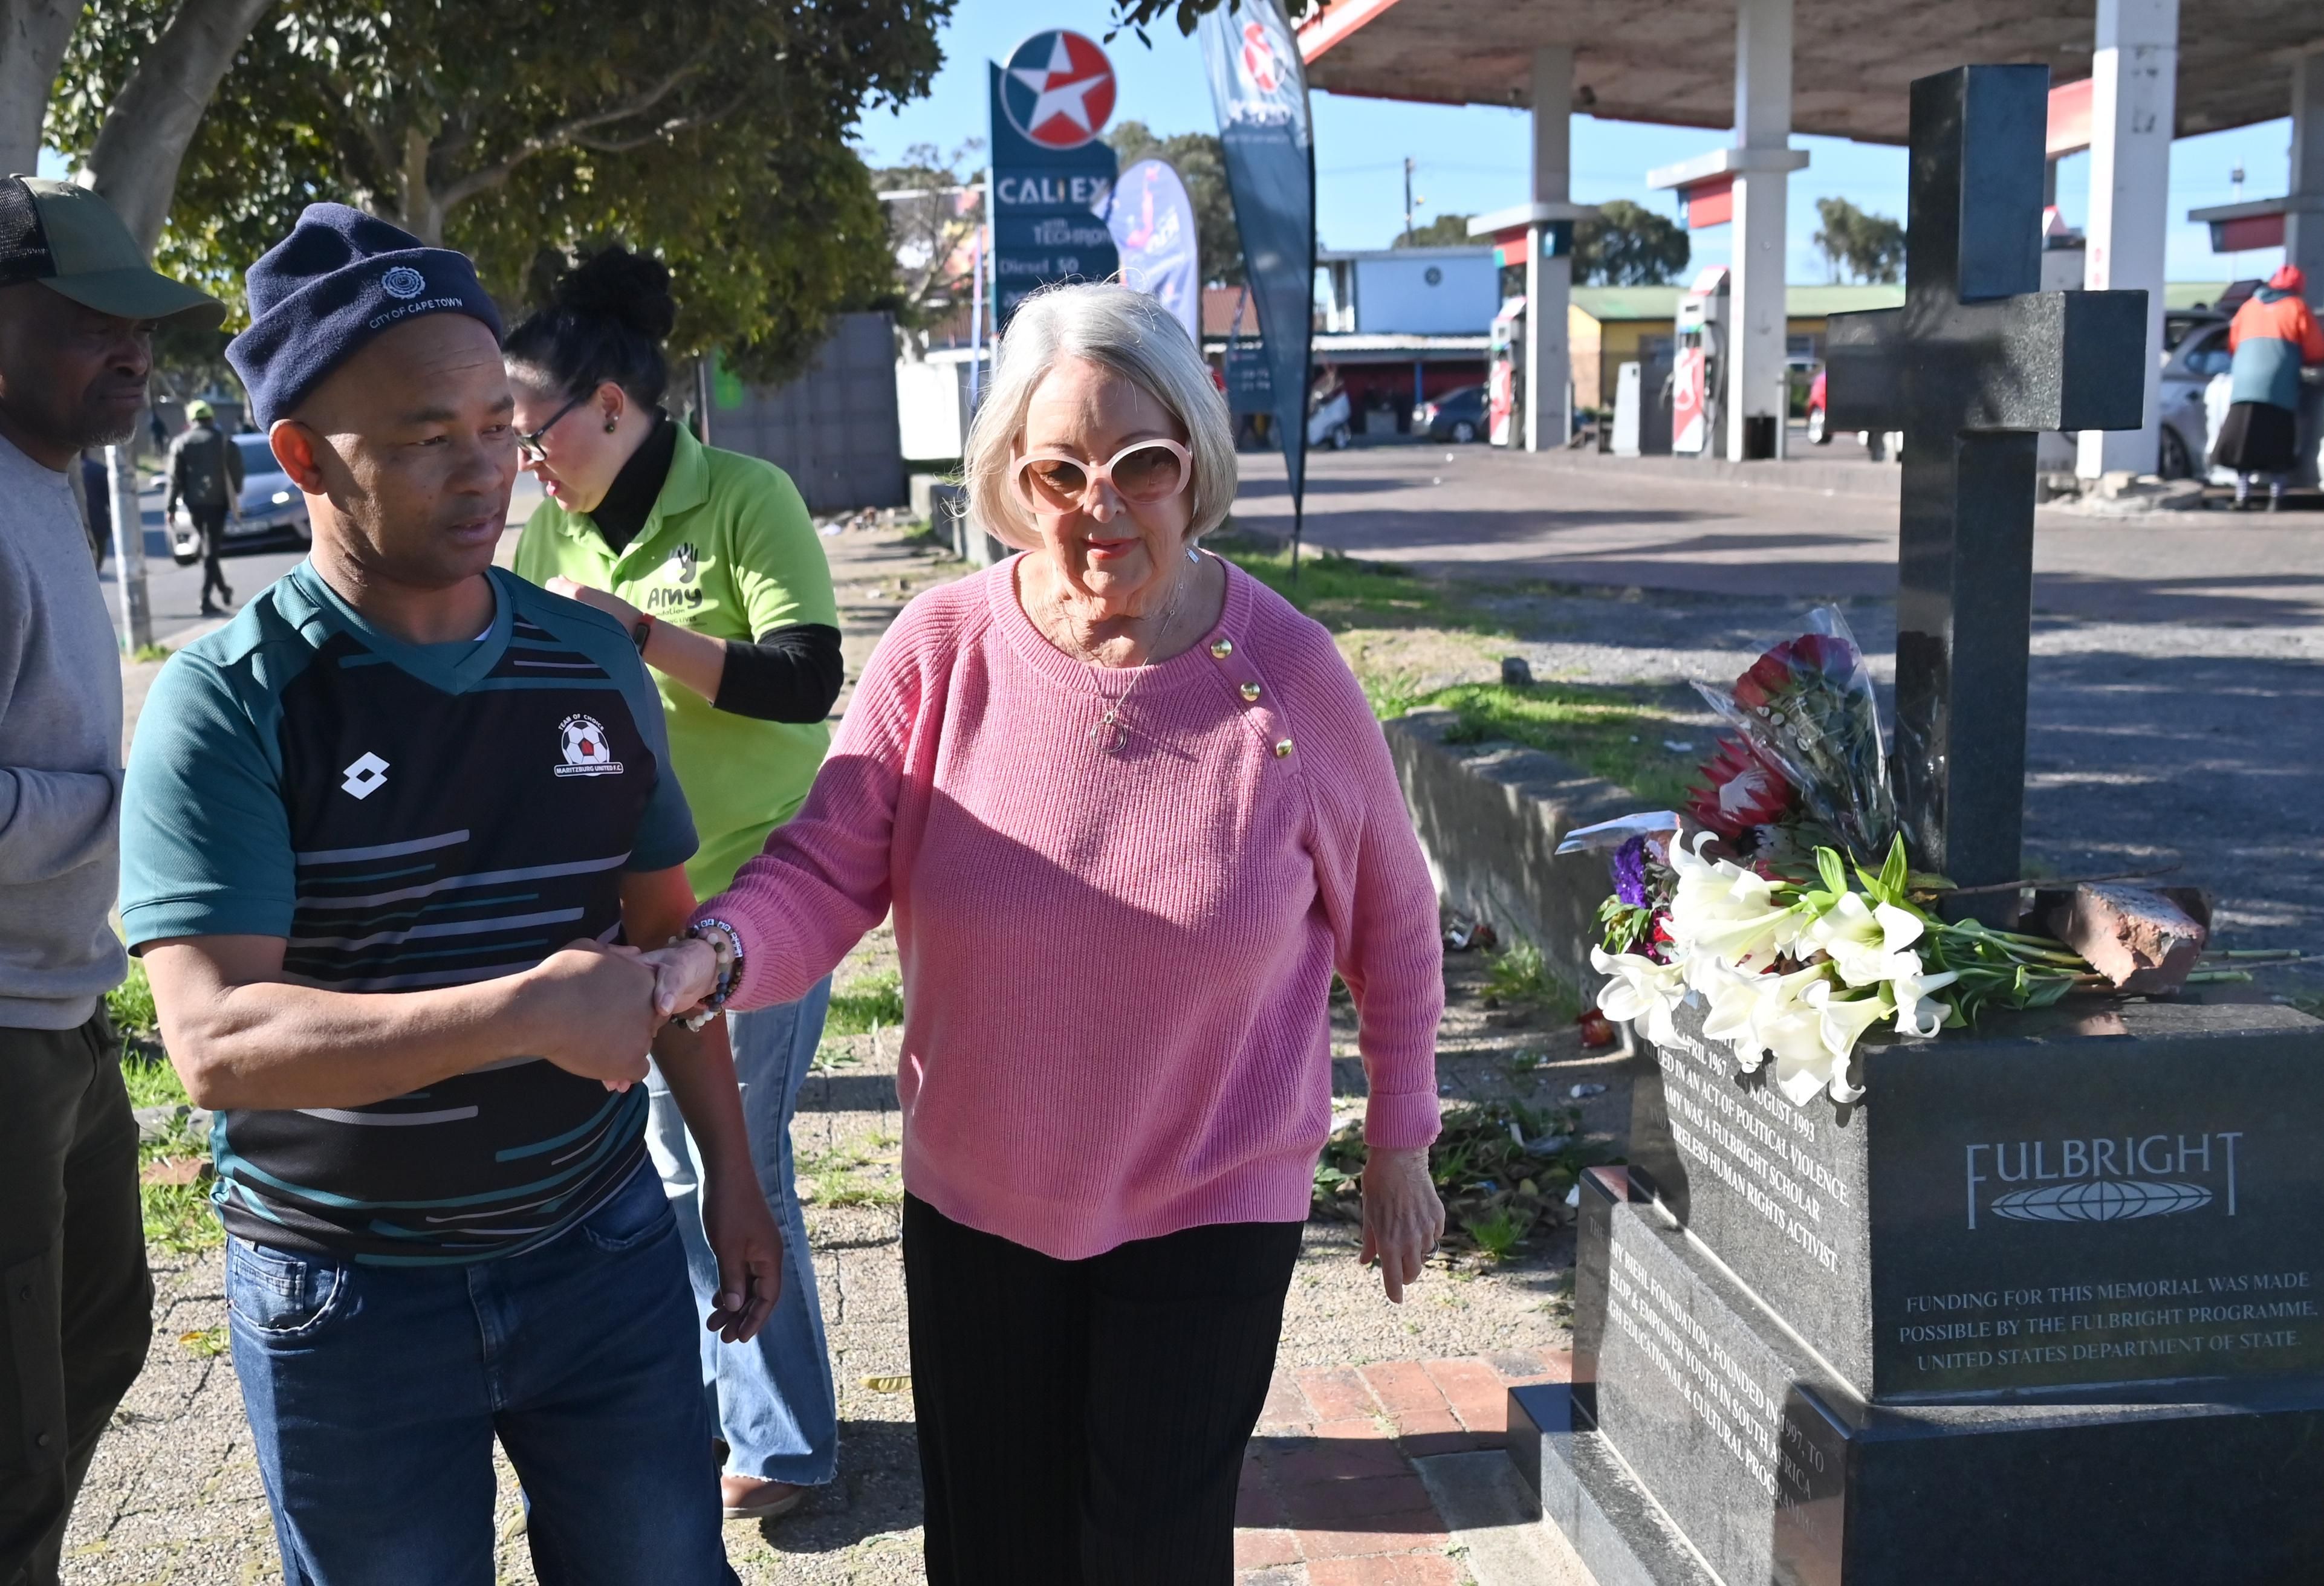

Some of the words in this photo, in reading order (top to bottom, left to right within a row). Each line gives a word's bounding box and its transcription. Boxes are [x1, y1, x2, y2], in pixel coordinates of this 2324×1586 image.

[369, 312, 391, 329] CITY
[391, 307, 406, 319] OF
[407, 300, 435, 313] CAPE
[434, 297, 463, 308] TOWN
[558, 716, 572, 731] TEAM
[583, 714, 605, 731] CHOICE
[1675, 1060, 1686, 1081] IN
[1687, 1069, 1700, 1092] AN
[1702, 1081, 1721, 1107] ACT
[1721, 1094, 1736, 1117] OF
[1736, 1104, 1789, 1160] POLITICAL
[1790, 1144, 1849, 1208] VIOLENCE.
[1709, 1051, 1727, 1079] 1967
[1750, 1086, 1791, 1125] AUGUST
[1793, 1112, 1814, 1143] 1993
[1664, 1084, 1683, 1111] AMY
[1684, 1098, 1703, 1128] WAS
[1704, 1116, 1710, 1134] A
[1712, 1120, 1768, 1179] FULBRIGHT
[1770, 1165, 1820, 1223] SCHOLAR
[1669, 1118, 1709, 1165] TIRELESS
[1710, 1151, 1746, 1196] HUMAN
[1747, 1182, 1785, 1229] RIGHTS
[1787, 1217, 1839, 1276] ACTIVIST.
[1966, 1131, 2244, 1230] FULBRIGHT
[1900, 1322, 1991, 1343] POSSIBLE
[1997, 1319, 2021, 1336] BY
[2027, 1317, 2066, 1333] THE
[2071, 1309, 2184, 1332] FULBRIGHT
[1907, 1292, 1998, 1313] FUNDING
[2004, 1289, 2043, 1306] FOR
[2047, 1286, 2092, 1302] THIS
[2098, 1278, 2204, 1301] MEMORIAL
[2209, 1275, 2249, 1292] WAS
[2253, 1272, 2311, 1290] MADE
[1588, 1215, 1606, 1243] THE
[1609, 1237, 1624, 1263] MY
[1625, 1251, 1650, 1290] BIEHL
[1713, 1342, 1764, 1408] FOUNDED
[1766, 1397, 1778, 1426] IN
[1780, 1414, 1805, 1458] 1997,
[1808, 1441, 1824, 1473] TO
[1623, 1312, 1683, 1393] EDUCATIONAL
[1684, 1382, 1692, 1402] &
[1693, 1391, 1744, 1461] CULTURAL
[1918, 1351, 1993, 1371] UNITED
[1998, 1346, 2067, 1365] STATES
[2072, 1336, 2205, 1361] DEPARTMENT
[2210, 1335, 2234, 1351] OF
[2239, 1330, 2302, 1349] STATE.
[1631, 1292, 1638, 1312] &
[1640, 1298, 1683, 1360] EMPOWER
[1686, 1346, 1718, 1397] YOUTH
[1720, 1384, 1731, 1411] IN
[1733, 1399, 1768, 1455] SOUTH
[1770, 1442, 1811, 1500] AFRICA
